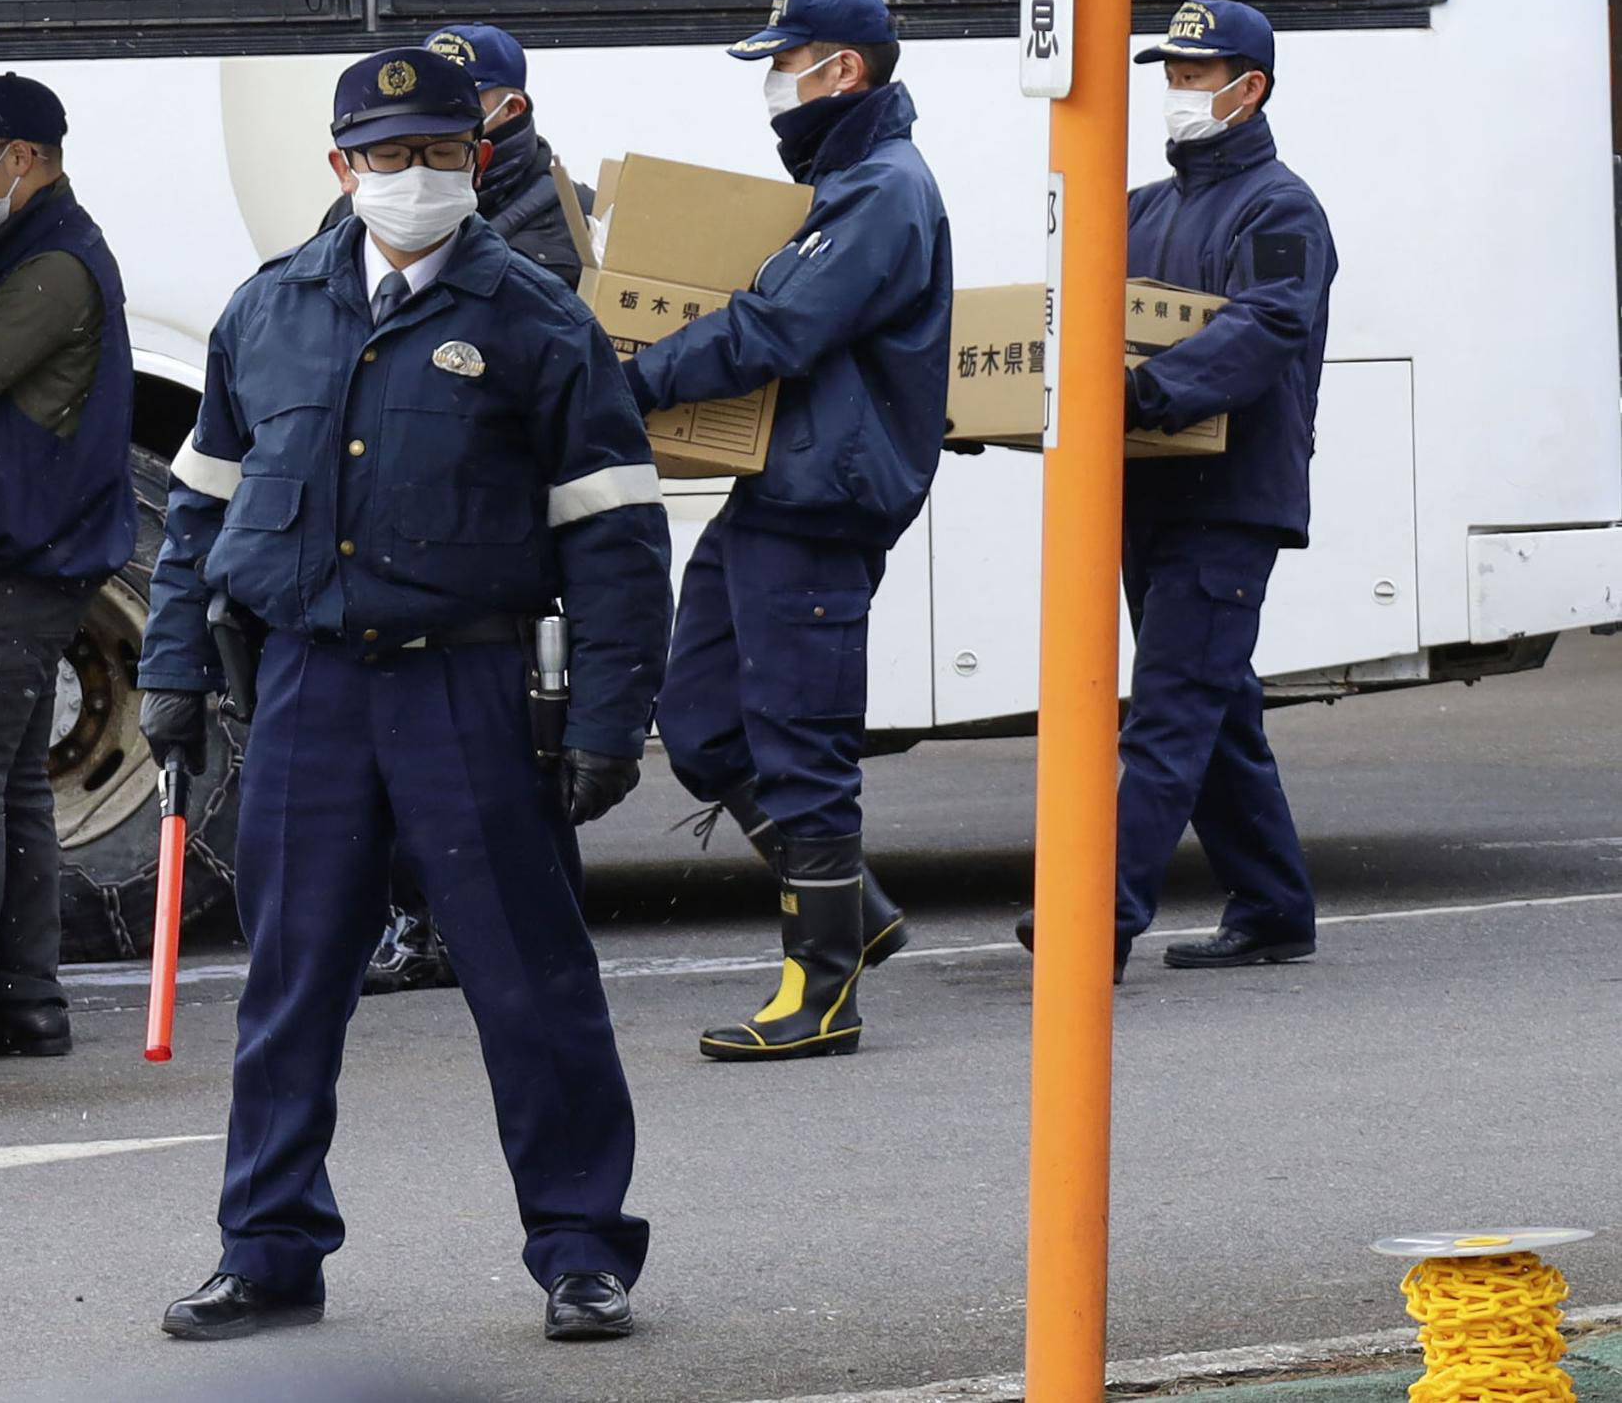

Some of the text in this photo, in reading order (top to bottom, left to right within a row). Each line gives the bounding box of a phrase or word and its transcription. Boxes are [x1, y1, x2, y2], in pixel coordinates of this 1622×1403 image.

[619, 289, 725, 321] 栃木県
[957, 340, 1045, 379] 栃木県警
